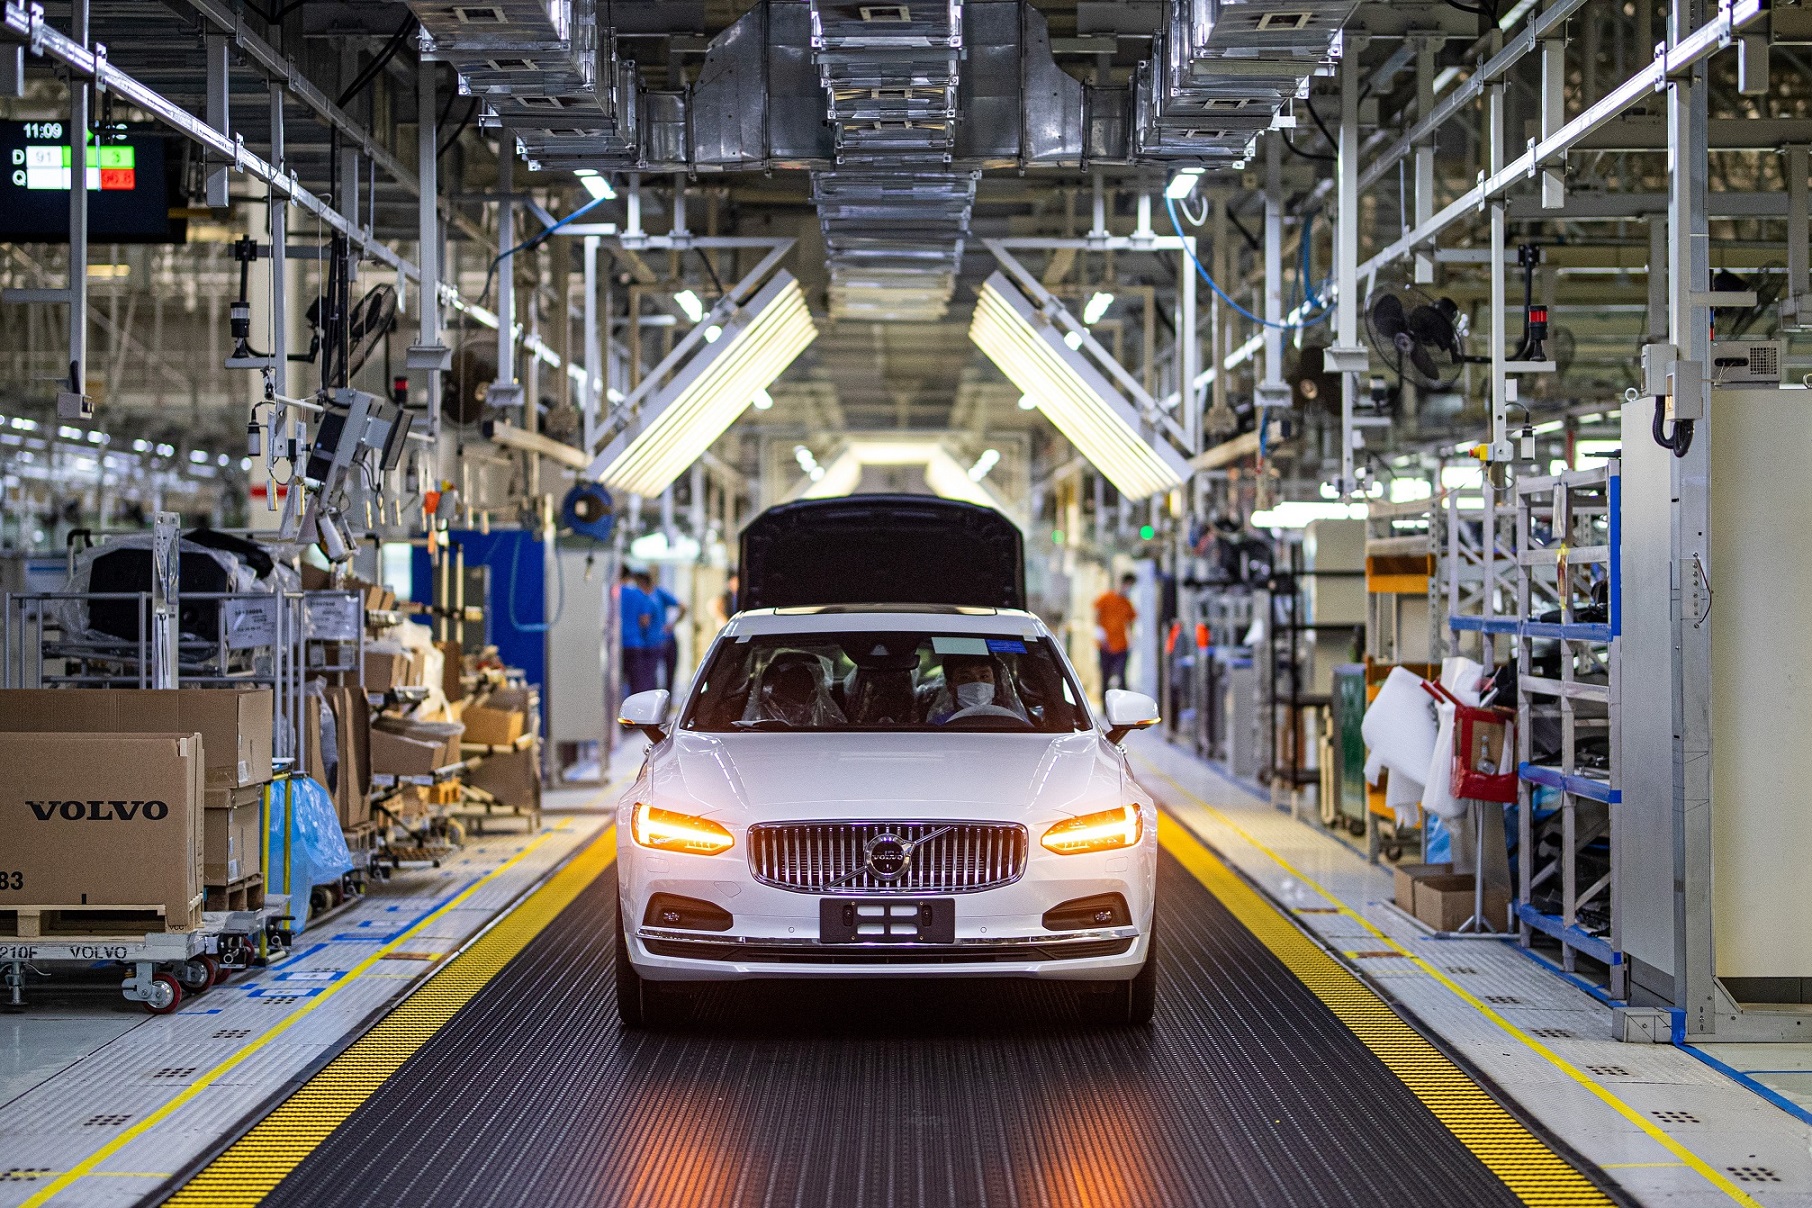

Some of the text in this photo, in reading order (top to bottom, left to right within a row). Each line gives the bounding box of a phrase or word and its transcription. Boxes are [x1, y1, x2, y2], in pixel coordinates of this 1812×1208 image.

[23, 122, 63, 139] 11:09
[12, 149, 25, 165] D
[12, 170, 27, 187] Q
[25, 800, 168, 820] VOLVO
[0, 871, 23, 890] 83
[70, 946, 128, 959] VOLVO
